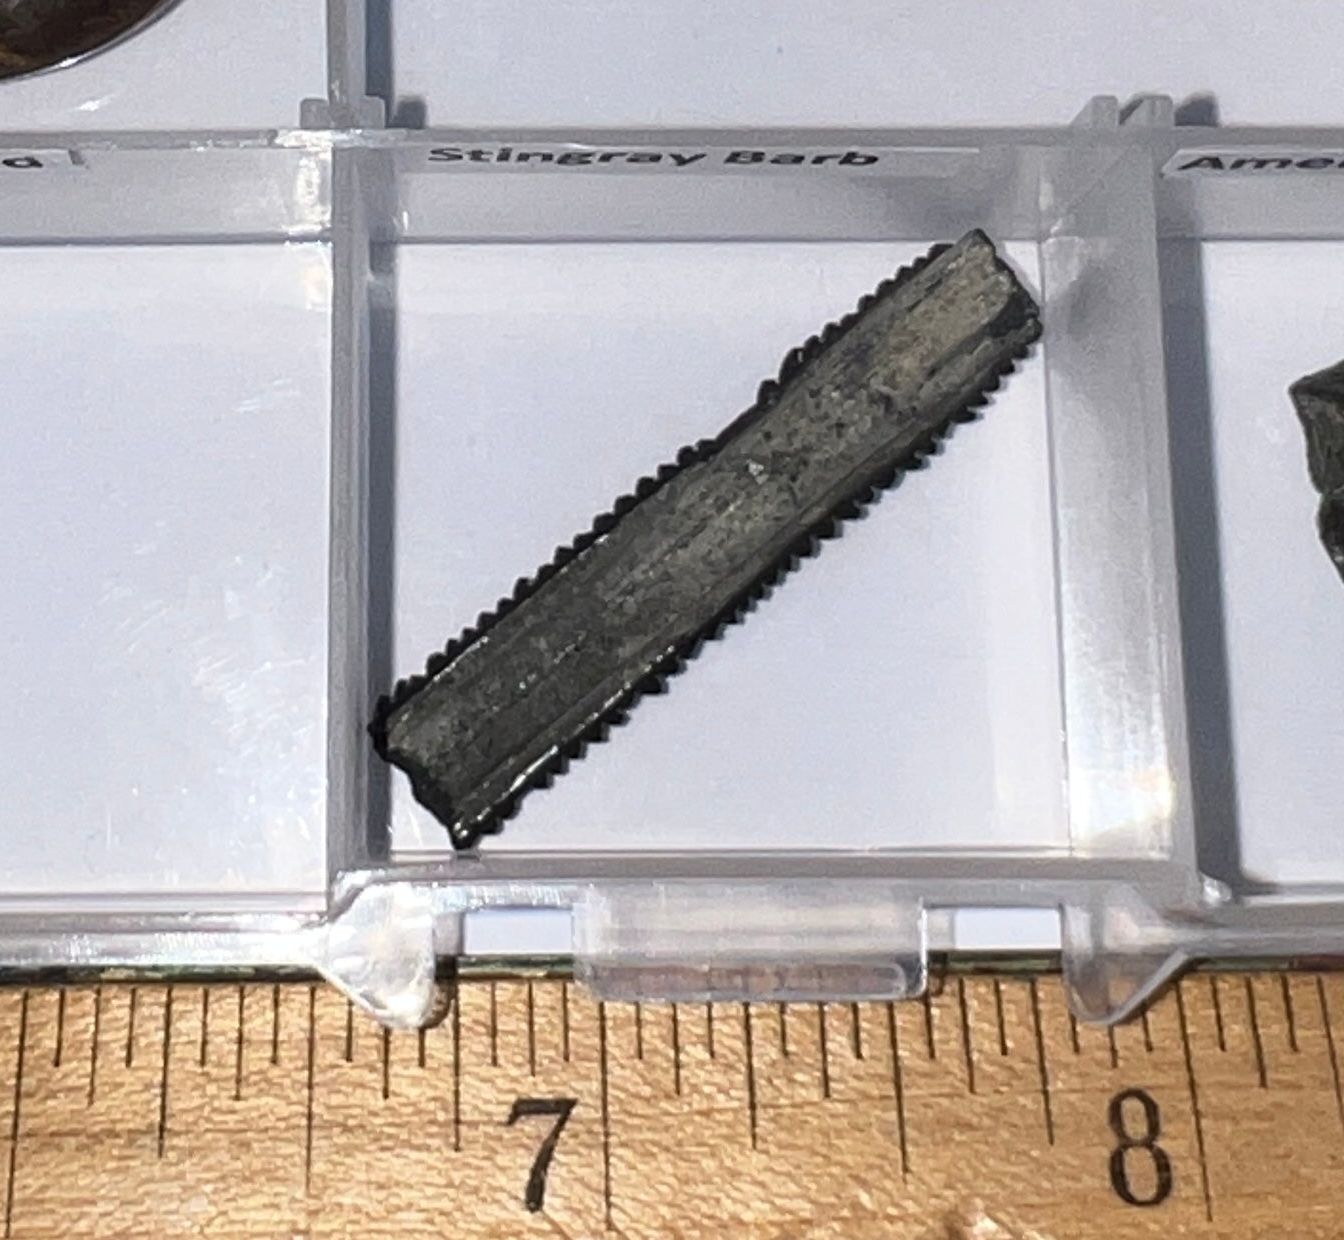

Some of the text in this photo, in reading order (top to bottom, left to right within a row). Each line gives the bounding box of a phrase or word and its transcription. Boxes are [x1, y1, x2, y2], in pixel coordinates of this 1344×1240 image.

[426, 146, 880, 167] Stingray Barb
[505, 1096, 579, 1212] 7
[1106, 1087, 1174, 1207] 8
